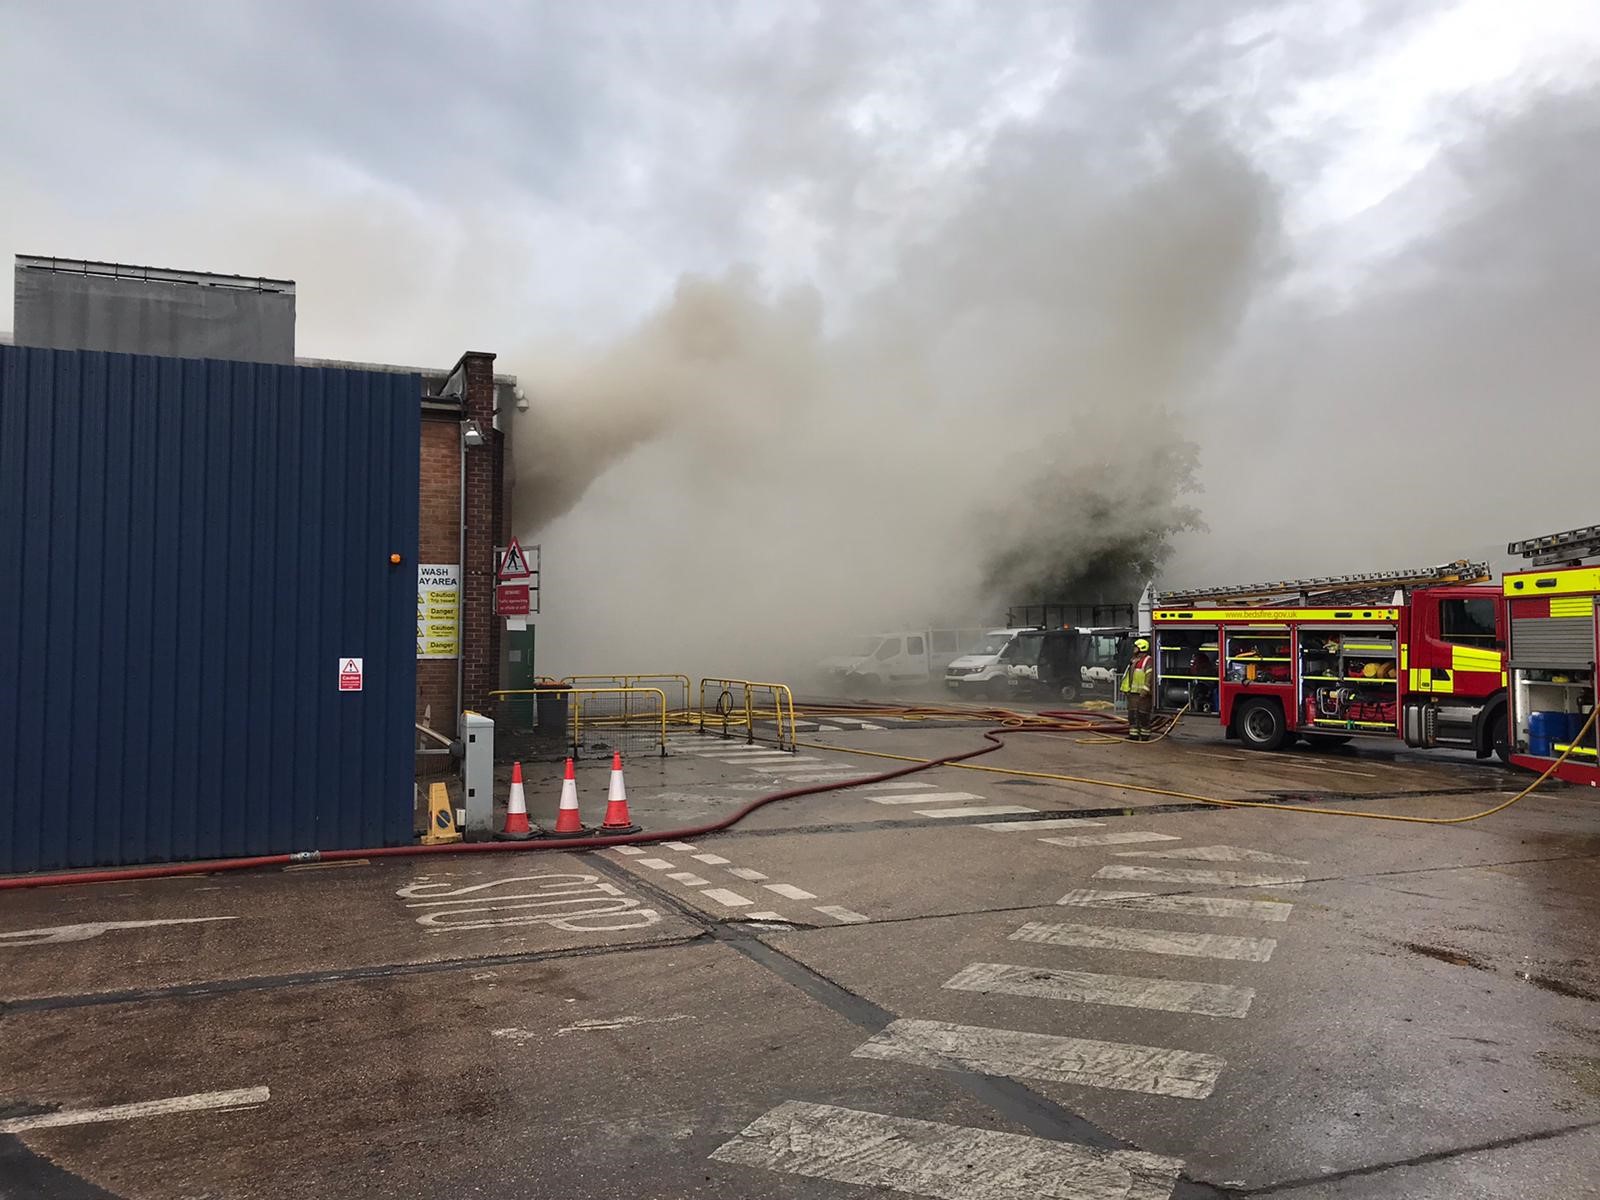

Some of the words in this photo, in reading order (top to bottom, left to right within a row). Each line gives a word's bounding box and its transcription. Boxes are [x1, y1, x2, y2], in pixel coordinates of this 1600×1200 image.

[421, 568, 449, 576] WASH
[1225, 610, 1297, 619] www.bedsfire.gov.uk
[395, 874, 664, 933] STOP
